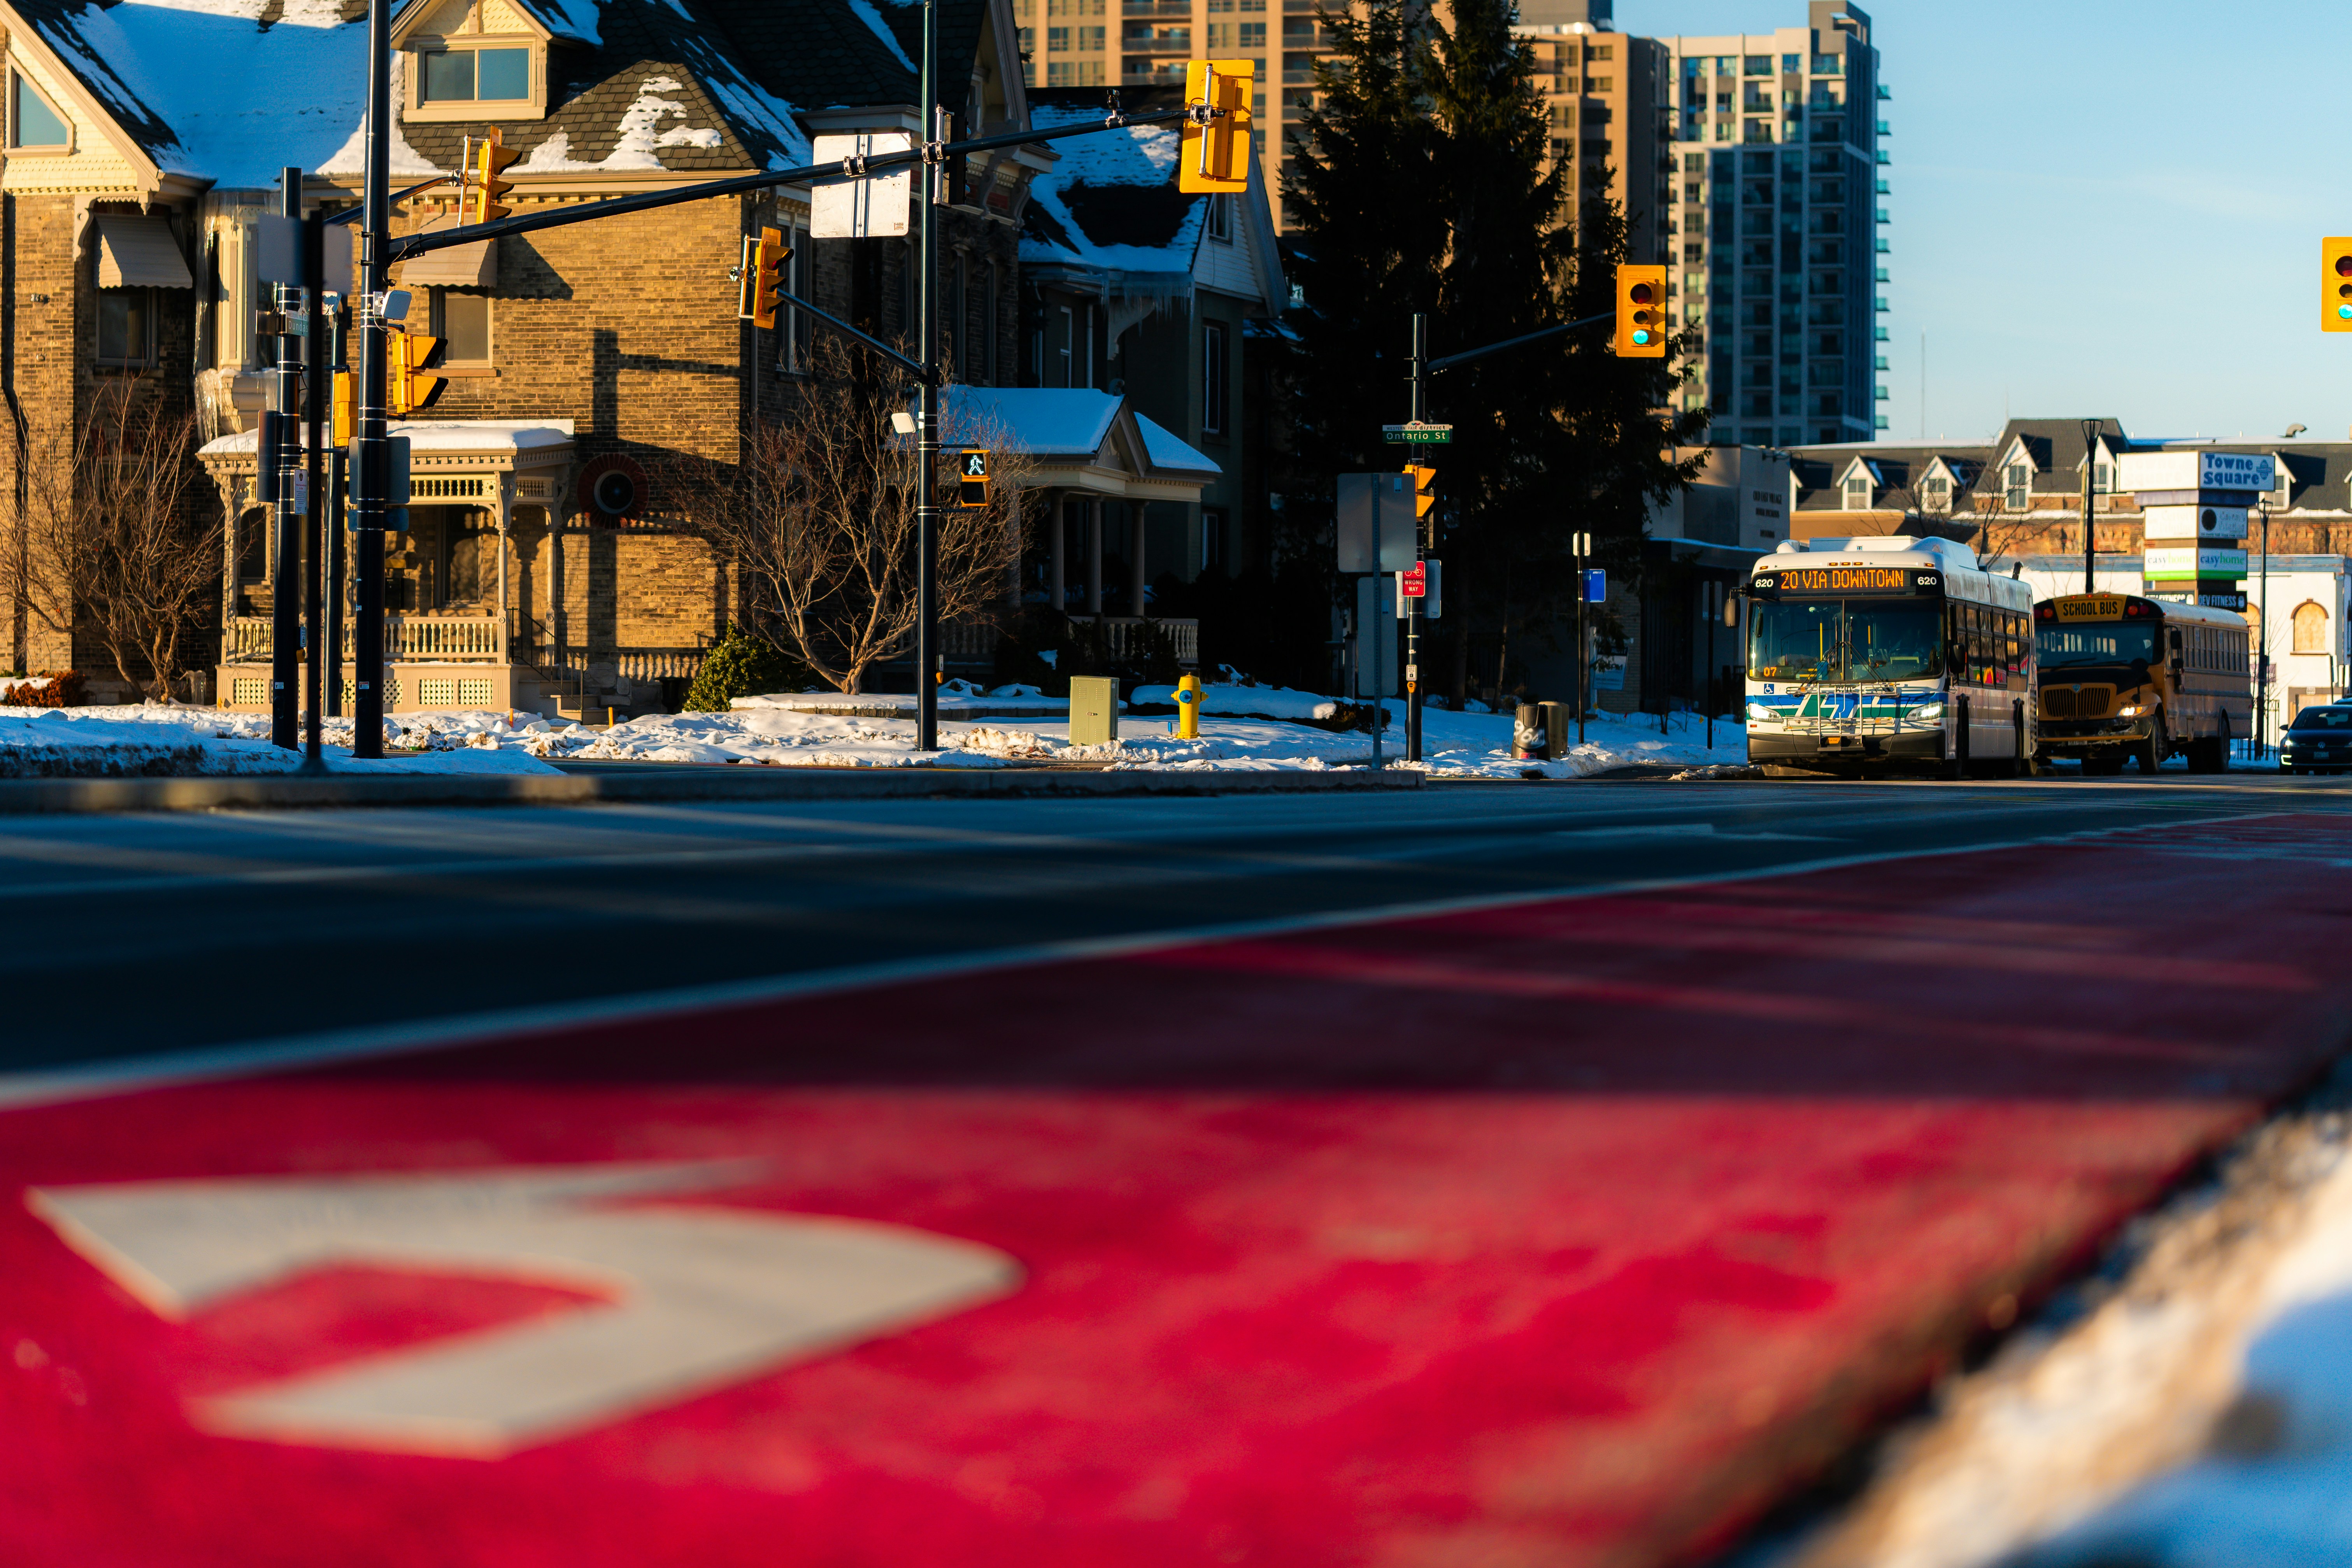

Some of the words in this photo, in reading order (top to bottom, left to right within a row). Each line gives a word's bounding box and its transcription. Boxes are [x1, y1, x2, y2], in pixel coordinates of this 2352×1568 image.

[289, 320, 308, 333] Dundas
[2205, 454, 2253, 470] Towne
[2200, 552, 2245, 568] easyhome
[1755, 579, 1773, 588] 620
[1781, 571, 1798, 589] 20
[1803, 570, 1827, 589] VIA
[1832, 569, 1904, 588] DOWNTOWN
[1917, 577, 1937, 585] 620
[2211, 595, 2236, 607] FITNESS
[2063, 602, 2097, 616] SCHOOL
[2100, 601, 2118, 615] BUS
[1764, 666, 1777, 677] 07
